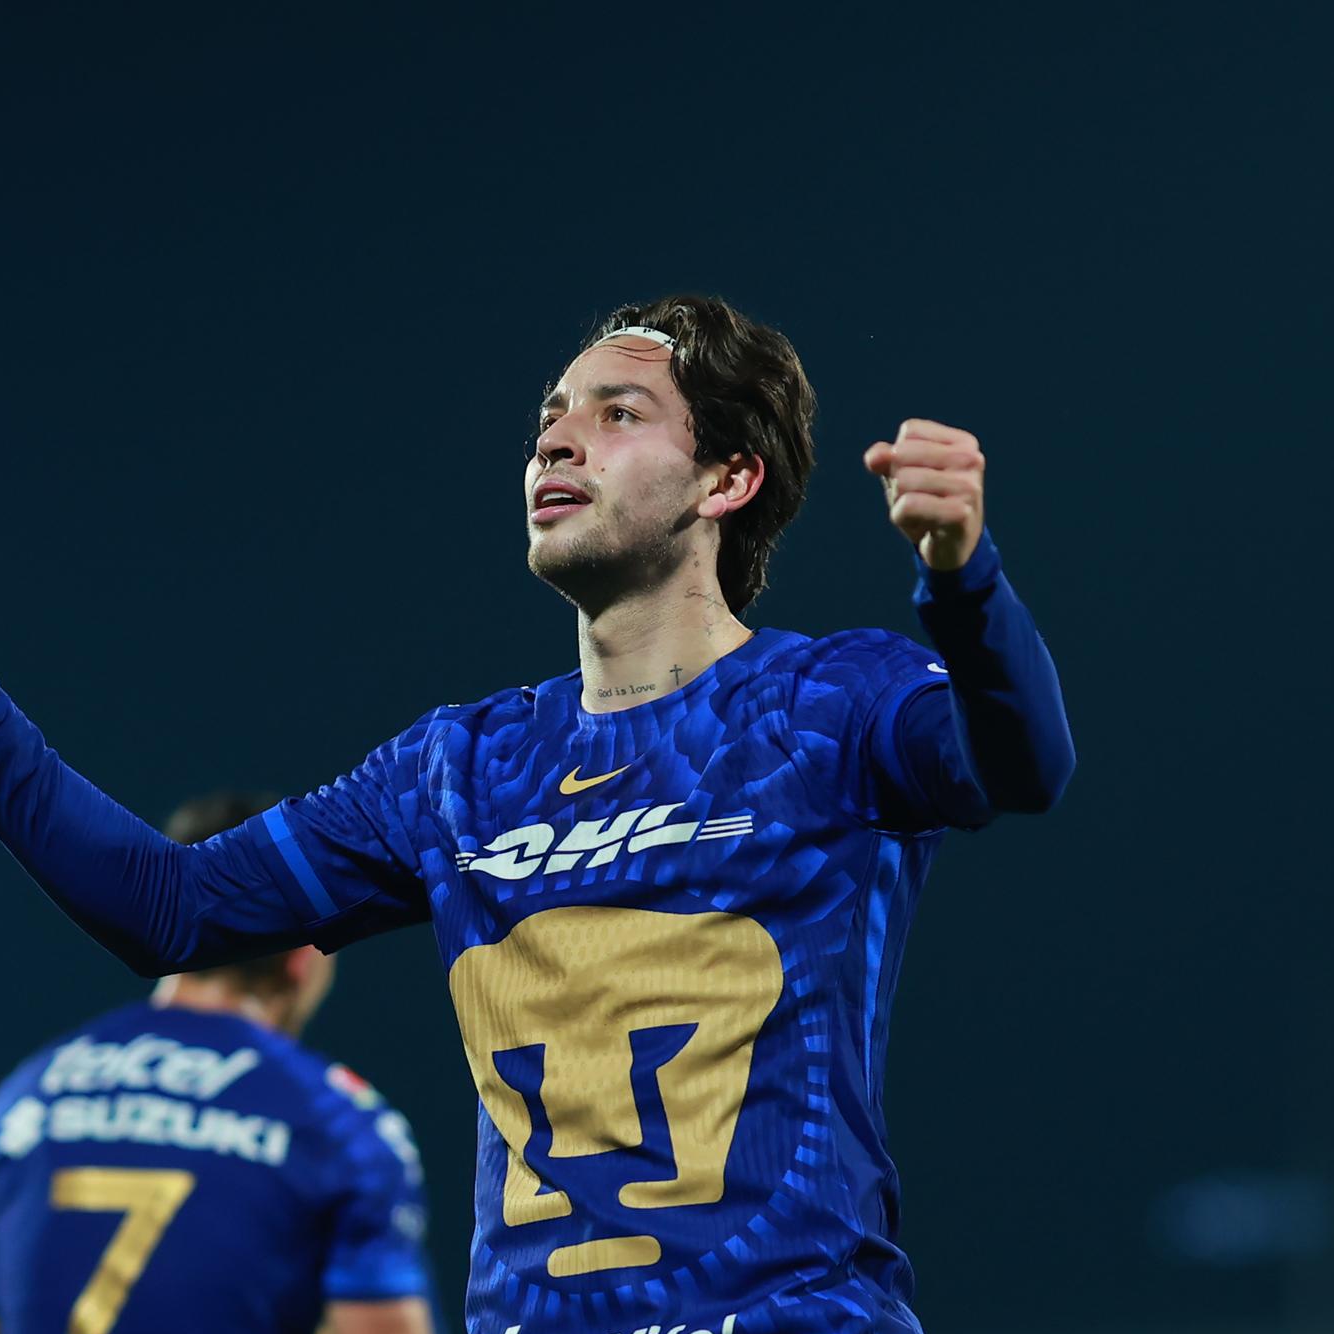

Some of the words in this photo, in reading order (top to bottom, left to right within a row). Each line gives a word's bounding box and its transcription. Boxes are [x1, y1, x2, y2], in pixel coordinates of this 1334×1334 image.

[597, 688, 612, 698] God
[616, 687, 627, 696] is
[630, 684, 656, 695] love
[468, 802, 701, 880] DHL
